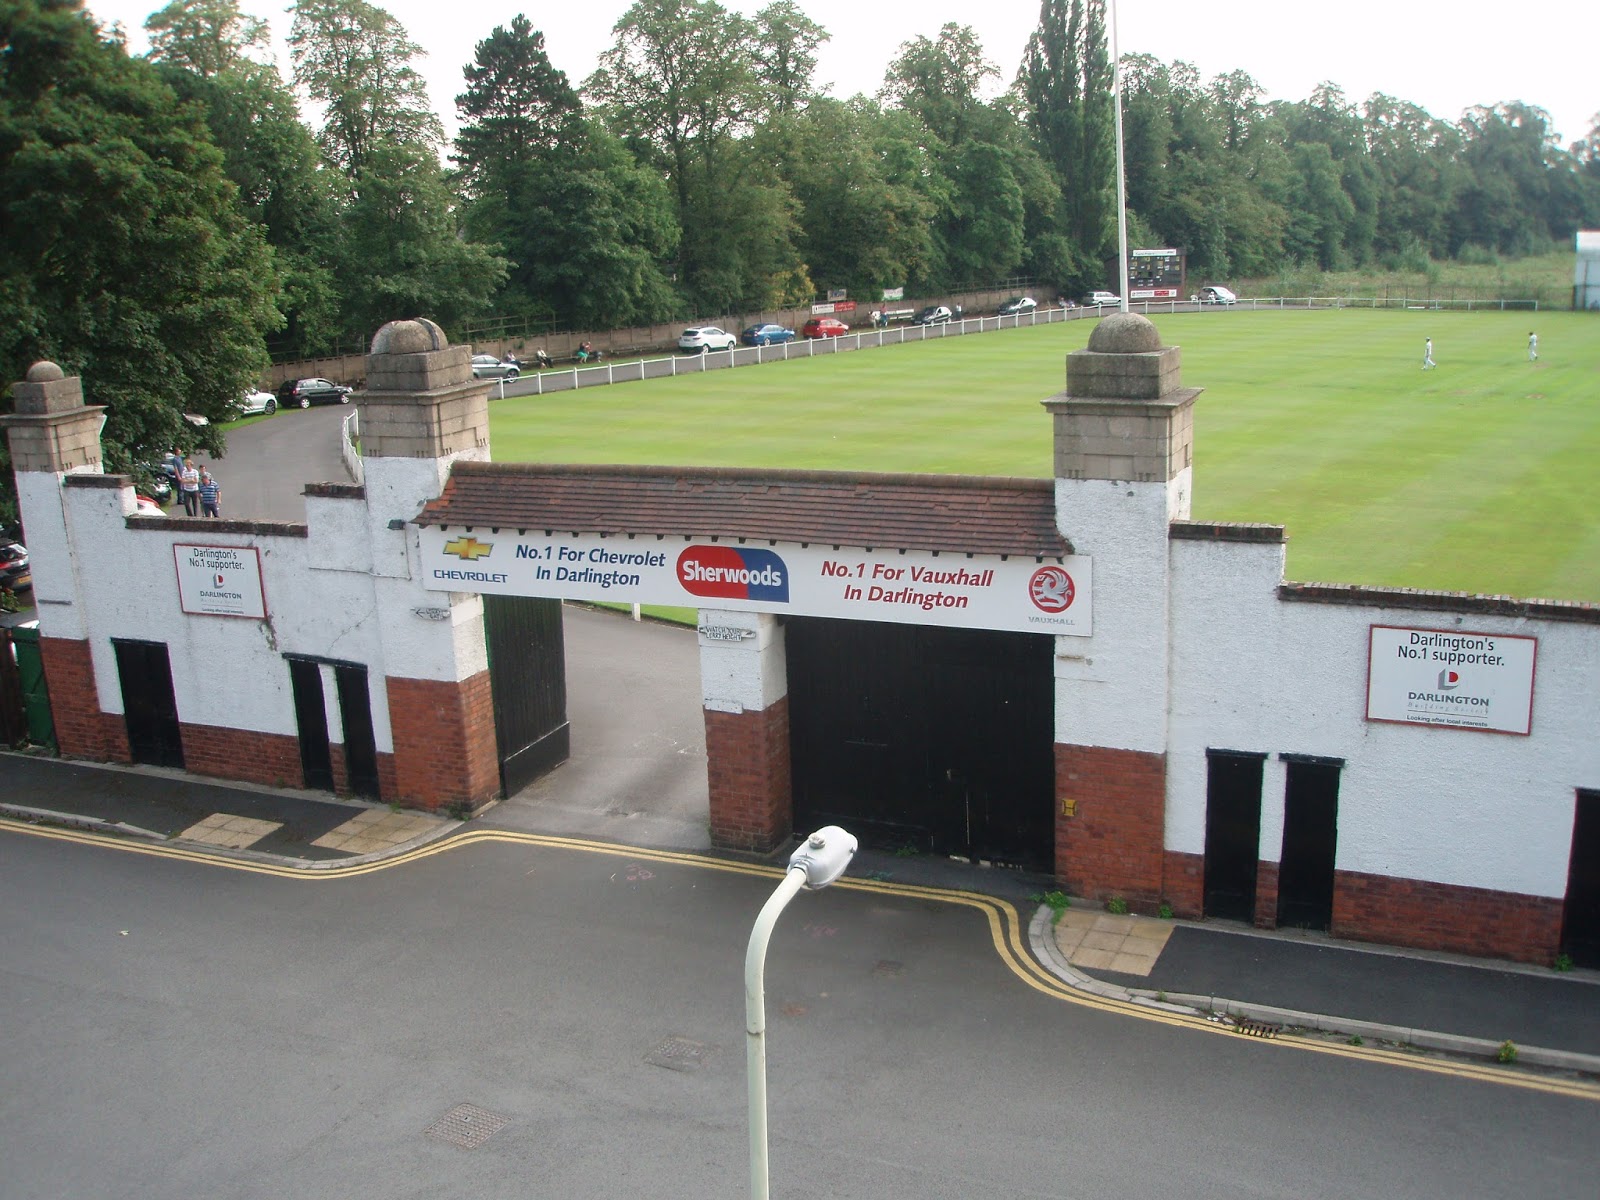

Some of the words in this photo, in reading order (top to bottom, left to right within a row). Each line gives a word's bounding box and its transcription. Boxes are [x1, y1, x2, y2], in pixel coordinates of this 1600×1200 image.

[193, 547, 237, 560] Darlington's
[515, 544, 553, 560] No.1
[558, 546, 585, 562] For
[588, 548, 666, 567] Chevrolet
[189, 557, 205, 568] No.1
[207, 560, 245, 571] supporter.
[433, 569, 508, 584] CHEVROLET
[536, 565, 550, 580] In
[555, 567, 641, 588] Darlington
[682, 559, 782, 588] Sherwoods
[820, 560, 866, 578] No.1
[871, 563, 905, 581] For
[910, 566, 995, 587] Vauxhall
[200, 590, 242, 600] DARLINGTON
[844, 584, 862, 601] In
[867, 586, 969, 611] Darlington
[1028, 616, 1076, 626] VAUXHALL
[1410, 632, 1495, 651] Darlington's
[1398, 645, 1428, 660] No.1
[1432, 650, 1505, 667] supporter.
[1408, 691, 1490, 706] DARLINGTON
[1406, 714, 1431, 723] Looking
